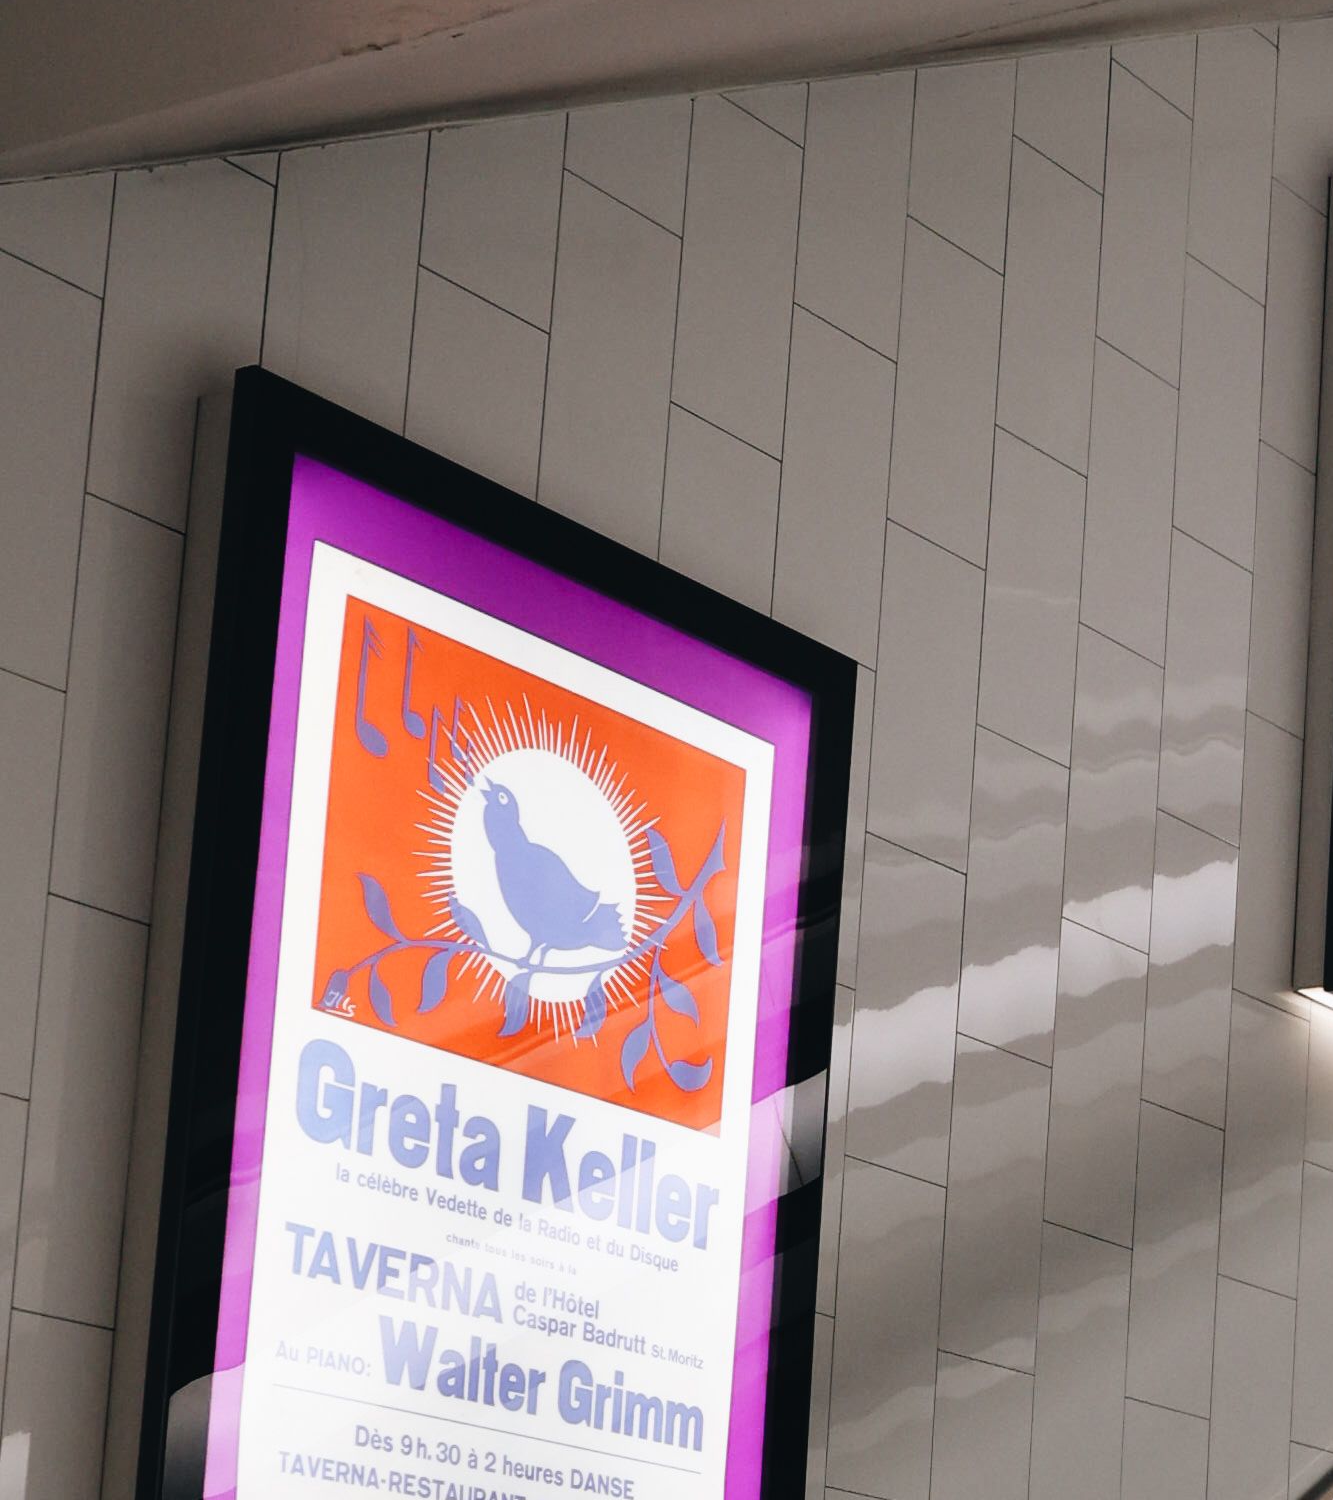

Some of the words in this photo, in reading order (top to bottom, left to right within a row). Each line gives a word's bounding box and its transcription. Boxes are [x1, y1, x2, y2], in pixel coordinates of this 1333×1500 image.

[296, 1038, 501, 1192] Greta
[521, 1103, 718, 1250] Keller
[335, 1161, 351, 1183] la
[356, 1172, 419, 1202] célèbre
[425, 1186, 487, 1220] Vedette
[492, 1207, 512, 1227] de
[517, 1211, 532, 1233] la
[536, 1216, 581, 1246] Radio
[585, 1234, 601, 1252] et
[605, 1237, 624, 1258] du
[629, 1243, 678, 1273] Disque
[285, 1221, 502, 1323] TAVERNA
[513, 1280, 536, 1304] de
[512, 1304, 577, 1338] Caspar
[582, 1320, 646, 1355] Badrutt
[275, 1339, 299, 1361] Au
[306, 1346, 371, 1377] PIANO:
[384, 1321, 546, 1415] Walter
[557, 1358, 704, 1452] Grimm
[354, 1424, 393, 1453] Dès
[467, 1447, 478, 1470] à
[483, 1451, 496, 1473] 2
[502, 1454, 564, 1487] heures
[569, 1467, 634, 1500] DANSE
